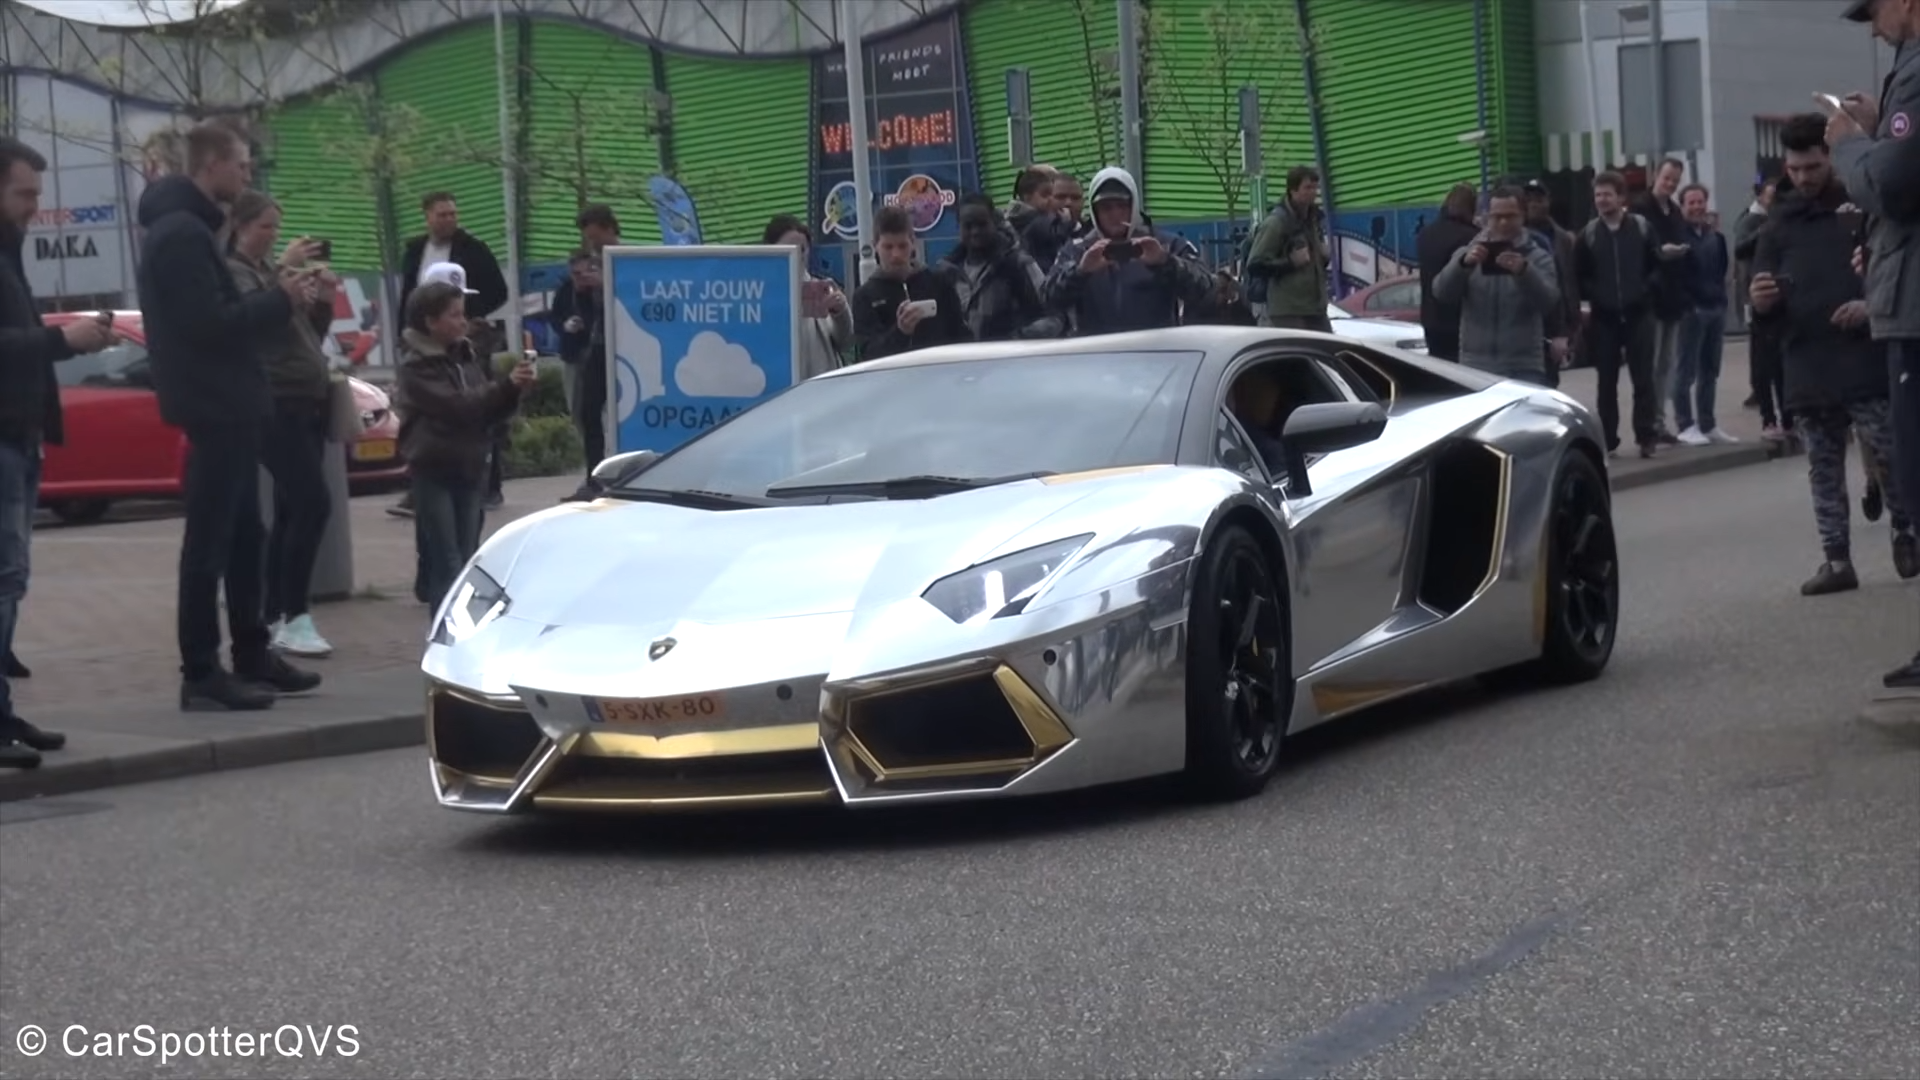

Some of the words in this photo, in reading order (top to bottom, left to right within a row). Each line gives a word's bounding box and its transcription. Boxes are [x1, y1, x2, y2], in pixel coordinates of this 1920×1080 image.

[30, 204, 115, 225] NTERSPORT
[35, 235, 99, 261] DAKA
[640, 280, 693, 300] LAAT
[699, 280, 764, 300] JOUW
[641, 302, 676, 322] €90
[683, 303, 733, 323] NIET
[740, 303, 761, 323] IN
[602, 697, 715, 721] 5-SXK-80
